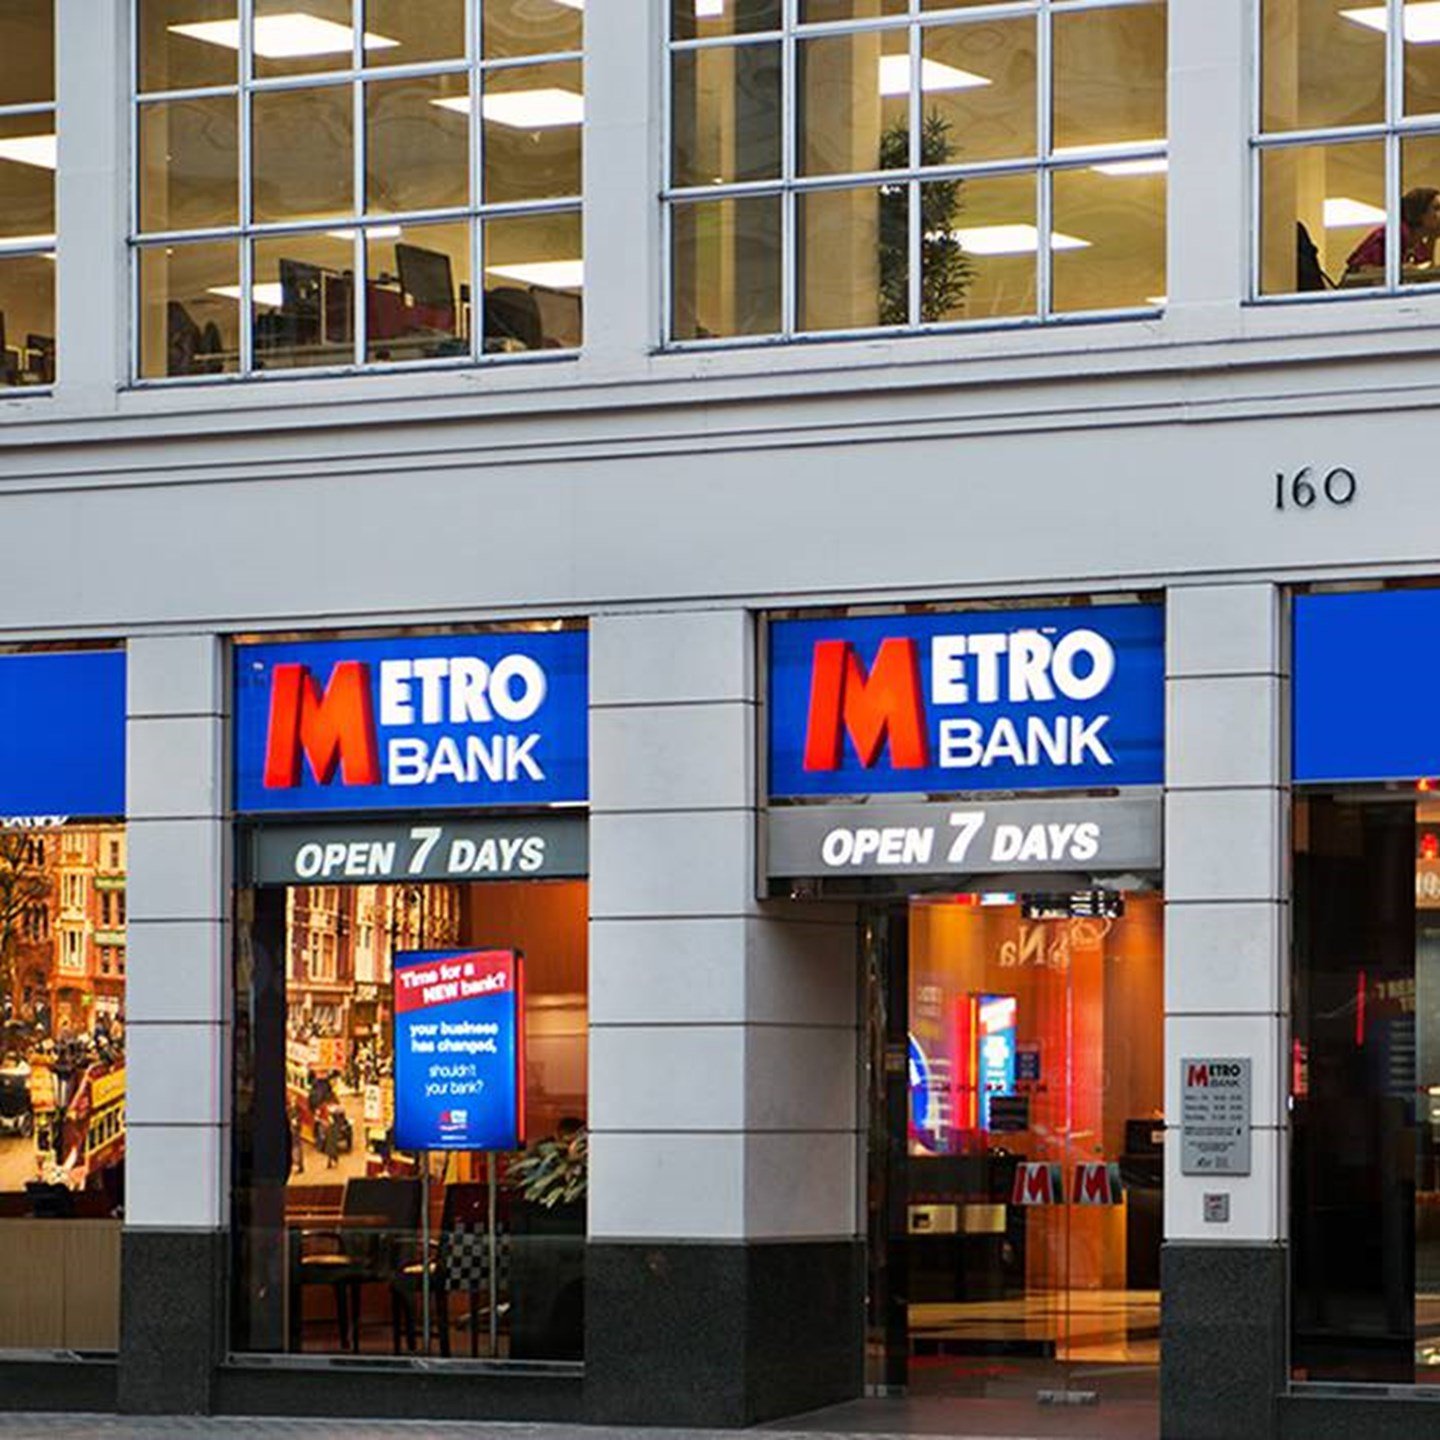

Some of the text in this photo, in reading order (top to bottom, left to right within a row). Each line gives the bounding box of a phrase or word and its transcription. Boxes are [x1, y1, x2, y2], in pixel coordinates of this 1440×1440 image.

[1274, 466, 1358, 511] 160
[264, 653, 548, 789] METRO
[803, 629, 1117, 772] METRO
[387, 734, 546, 786] BANK
[938, 715, 1116, 768] BANK
[295, 827, 546, 877] OPEN 7 DAYS
[821, 812, 1100, 866] OPEN 7 DAYS
[400, 962, 475, 989] Time for a
[423, 972, 506, 1004] NEW bank?
[409, 1020, 499, 1038] your business
[411, 1037, 497, 1055] has changed,
[425, 1080, 484, 1097] your bank?
